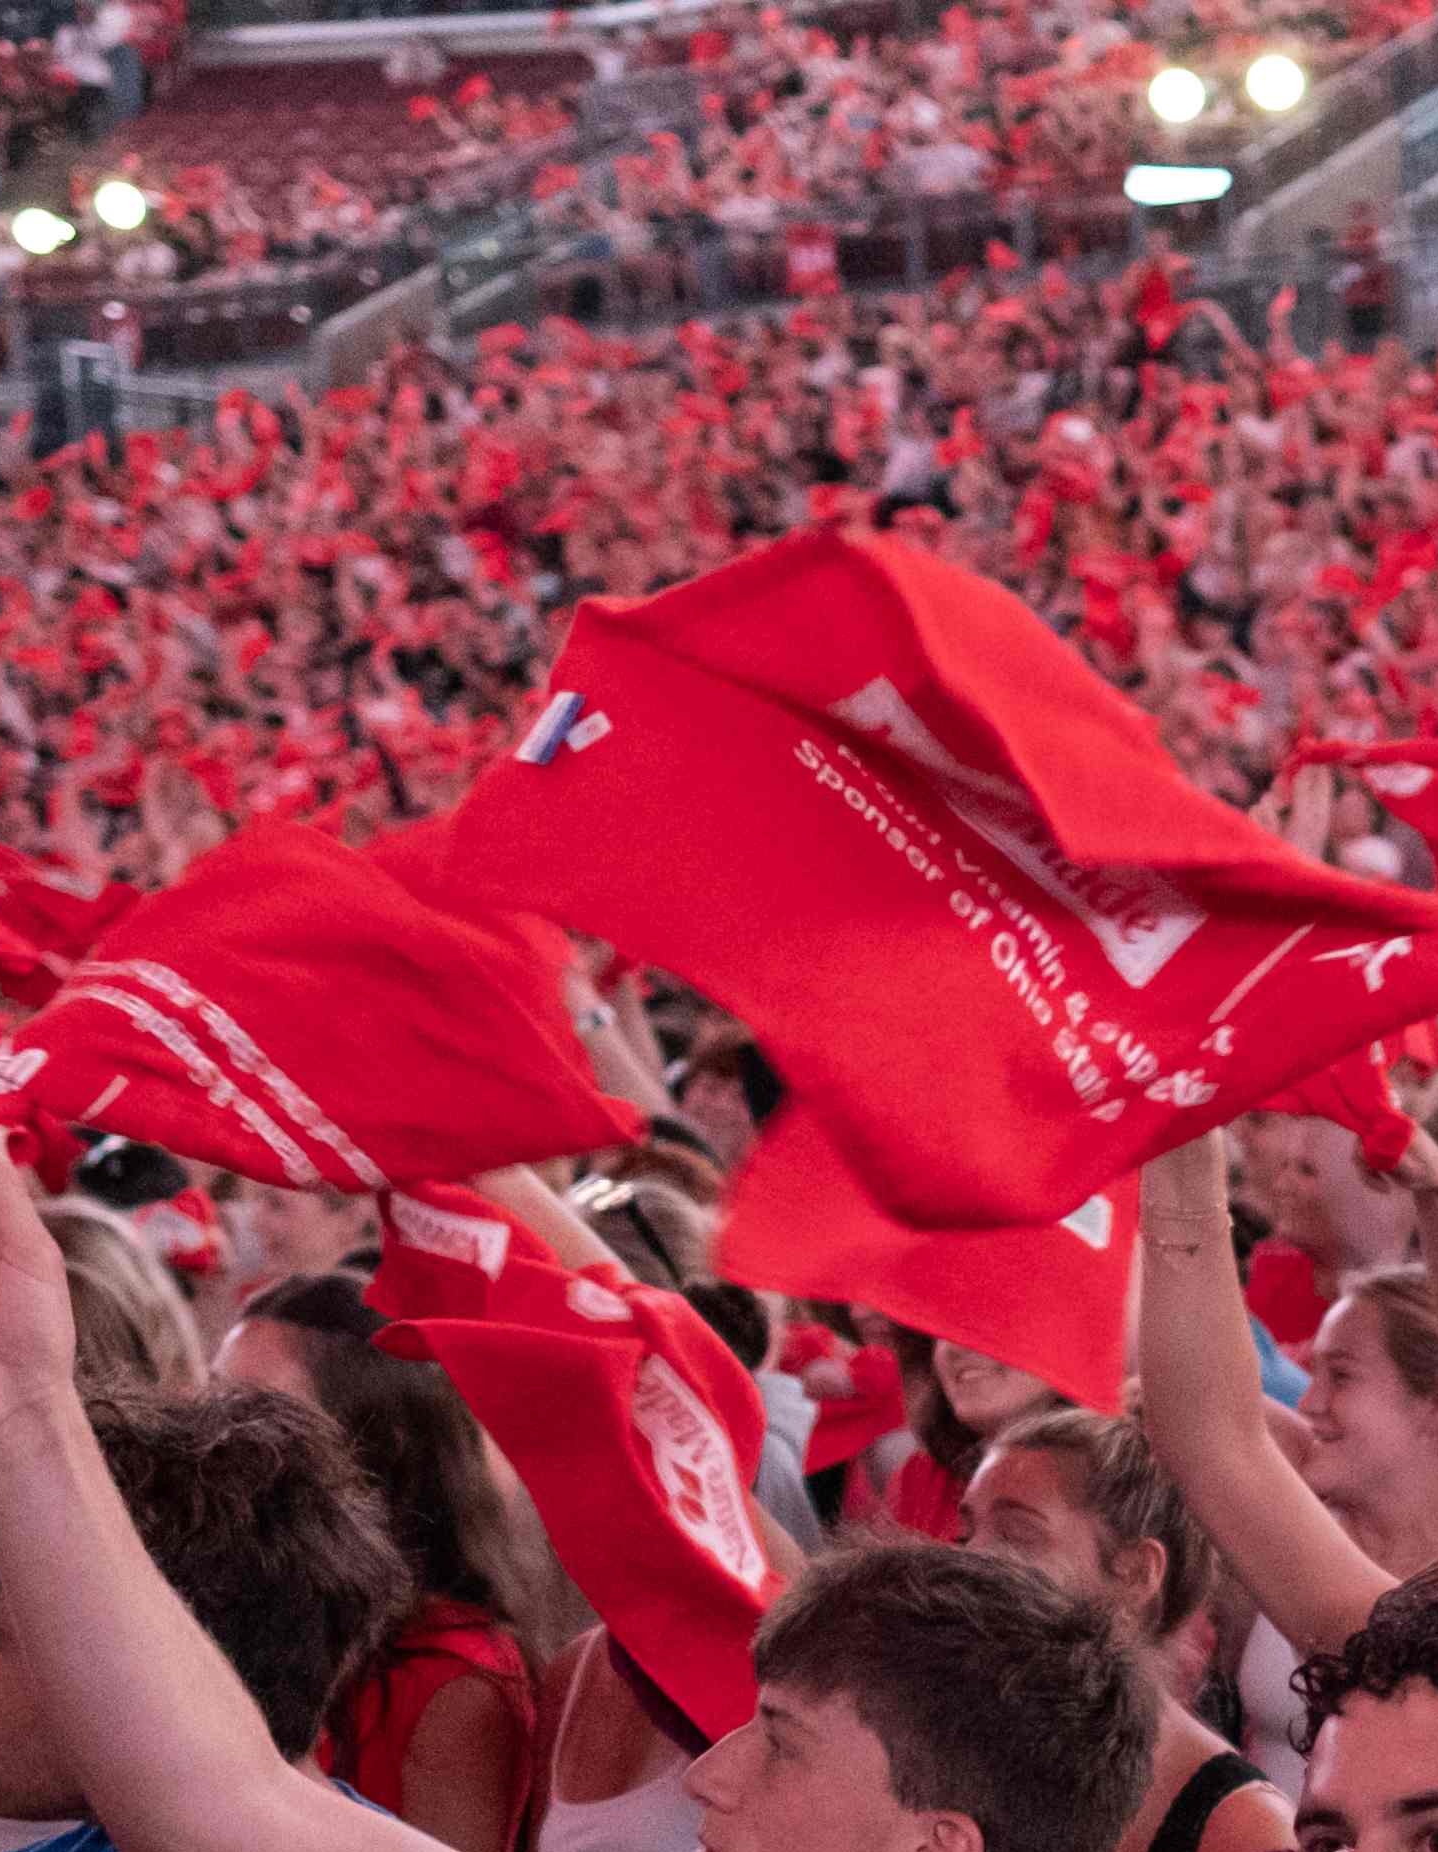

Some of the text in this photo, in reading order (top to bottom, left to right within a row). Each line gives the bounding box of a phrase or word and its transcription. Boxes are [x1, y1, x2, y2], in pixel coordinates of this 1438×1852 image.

[793, 738, 945, 882] Sponsor
[949, 889, 994, 930] of
[990, 931, 1054, 1027] Ohio
